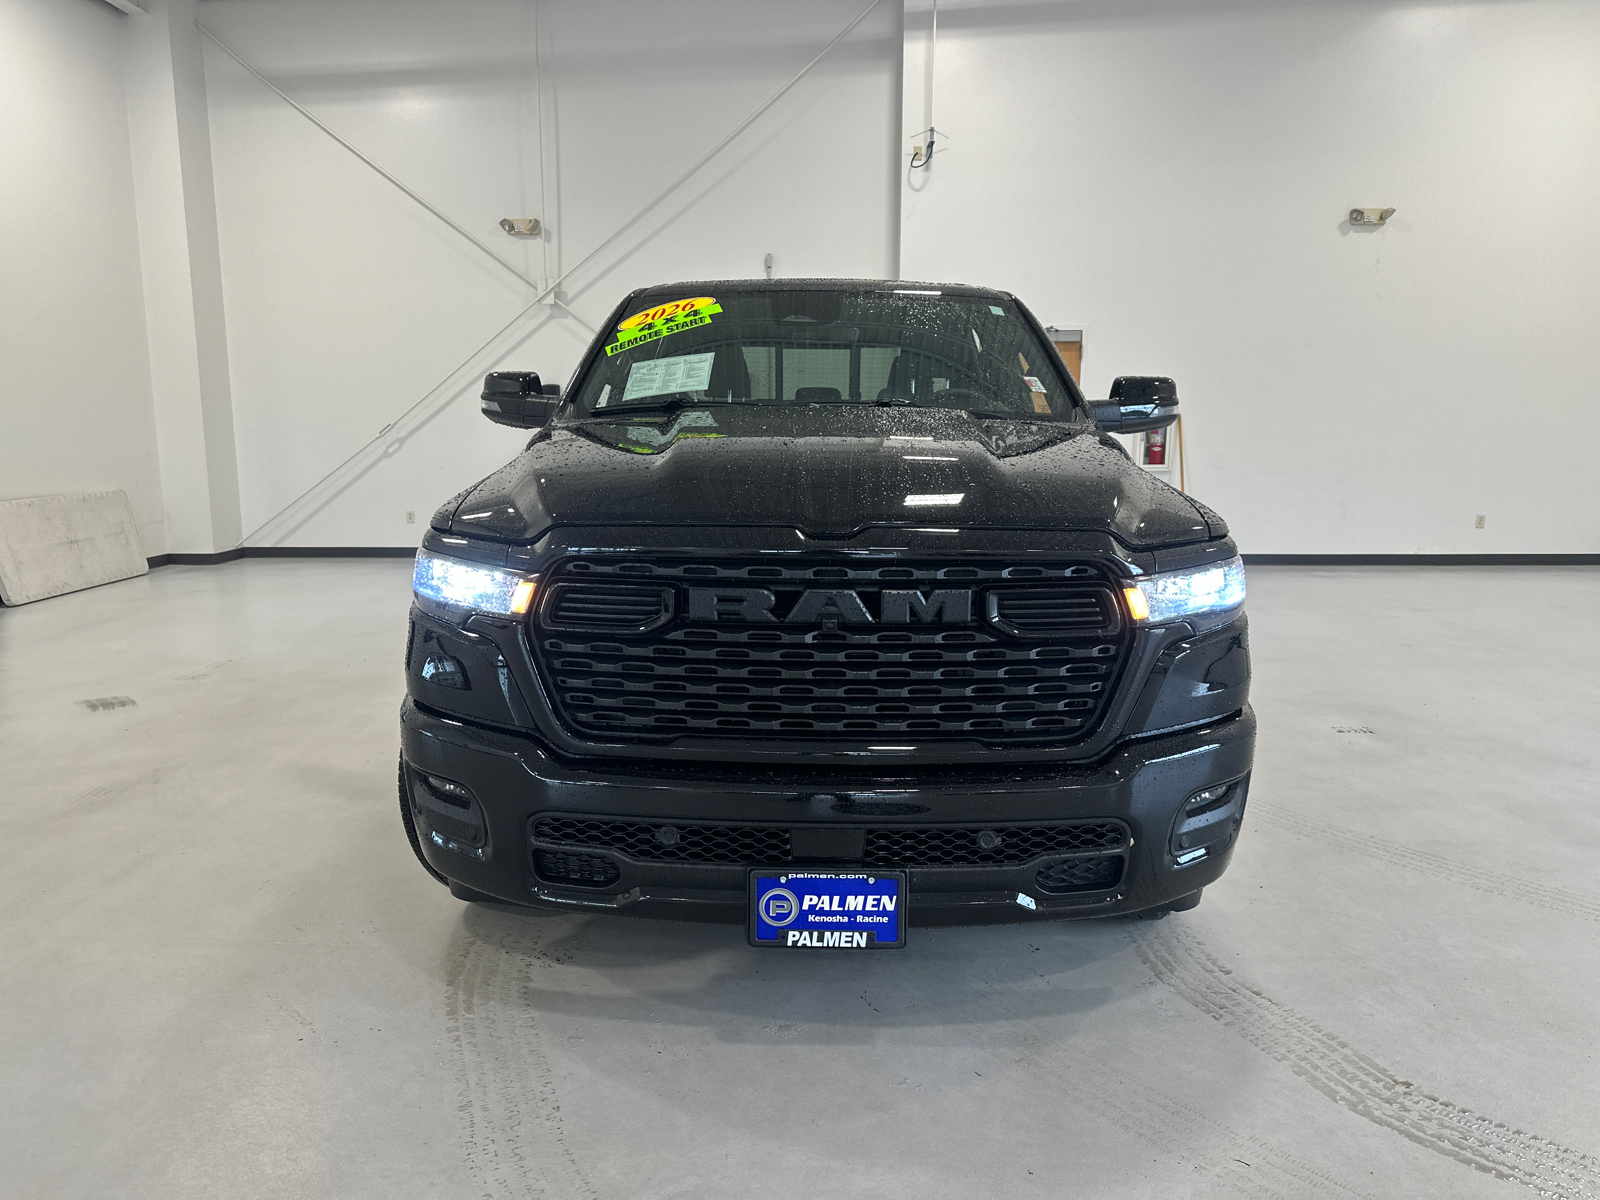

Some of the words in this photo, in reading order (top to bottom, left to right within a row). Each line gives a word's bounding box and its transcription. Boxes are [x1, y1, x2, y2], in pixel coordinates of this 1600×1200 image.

[635, 299, 697, 327] 2026
[610, 329, 663, 354] REMOTE
[666, 316, 707, 334] START
[688, 586, 972, 623] RAM
[788, 872, 867, 880] palmen.com
[801, 894, 897, 911] PALMEN
[808, 914, 848, 923] Kenosha
[856, 914, 889, 923] Racine
[786, 930, 867, 948] PALMEN
